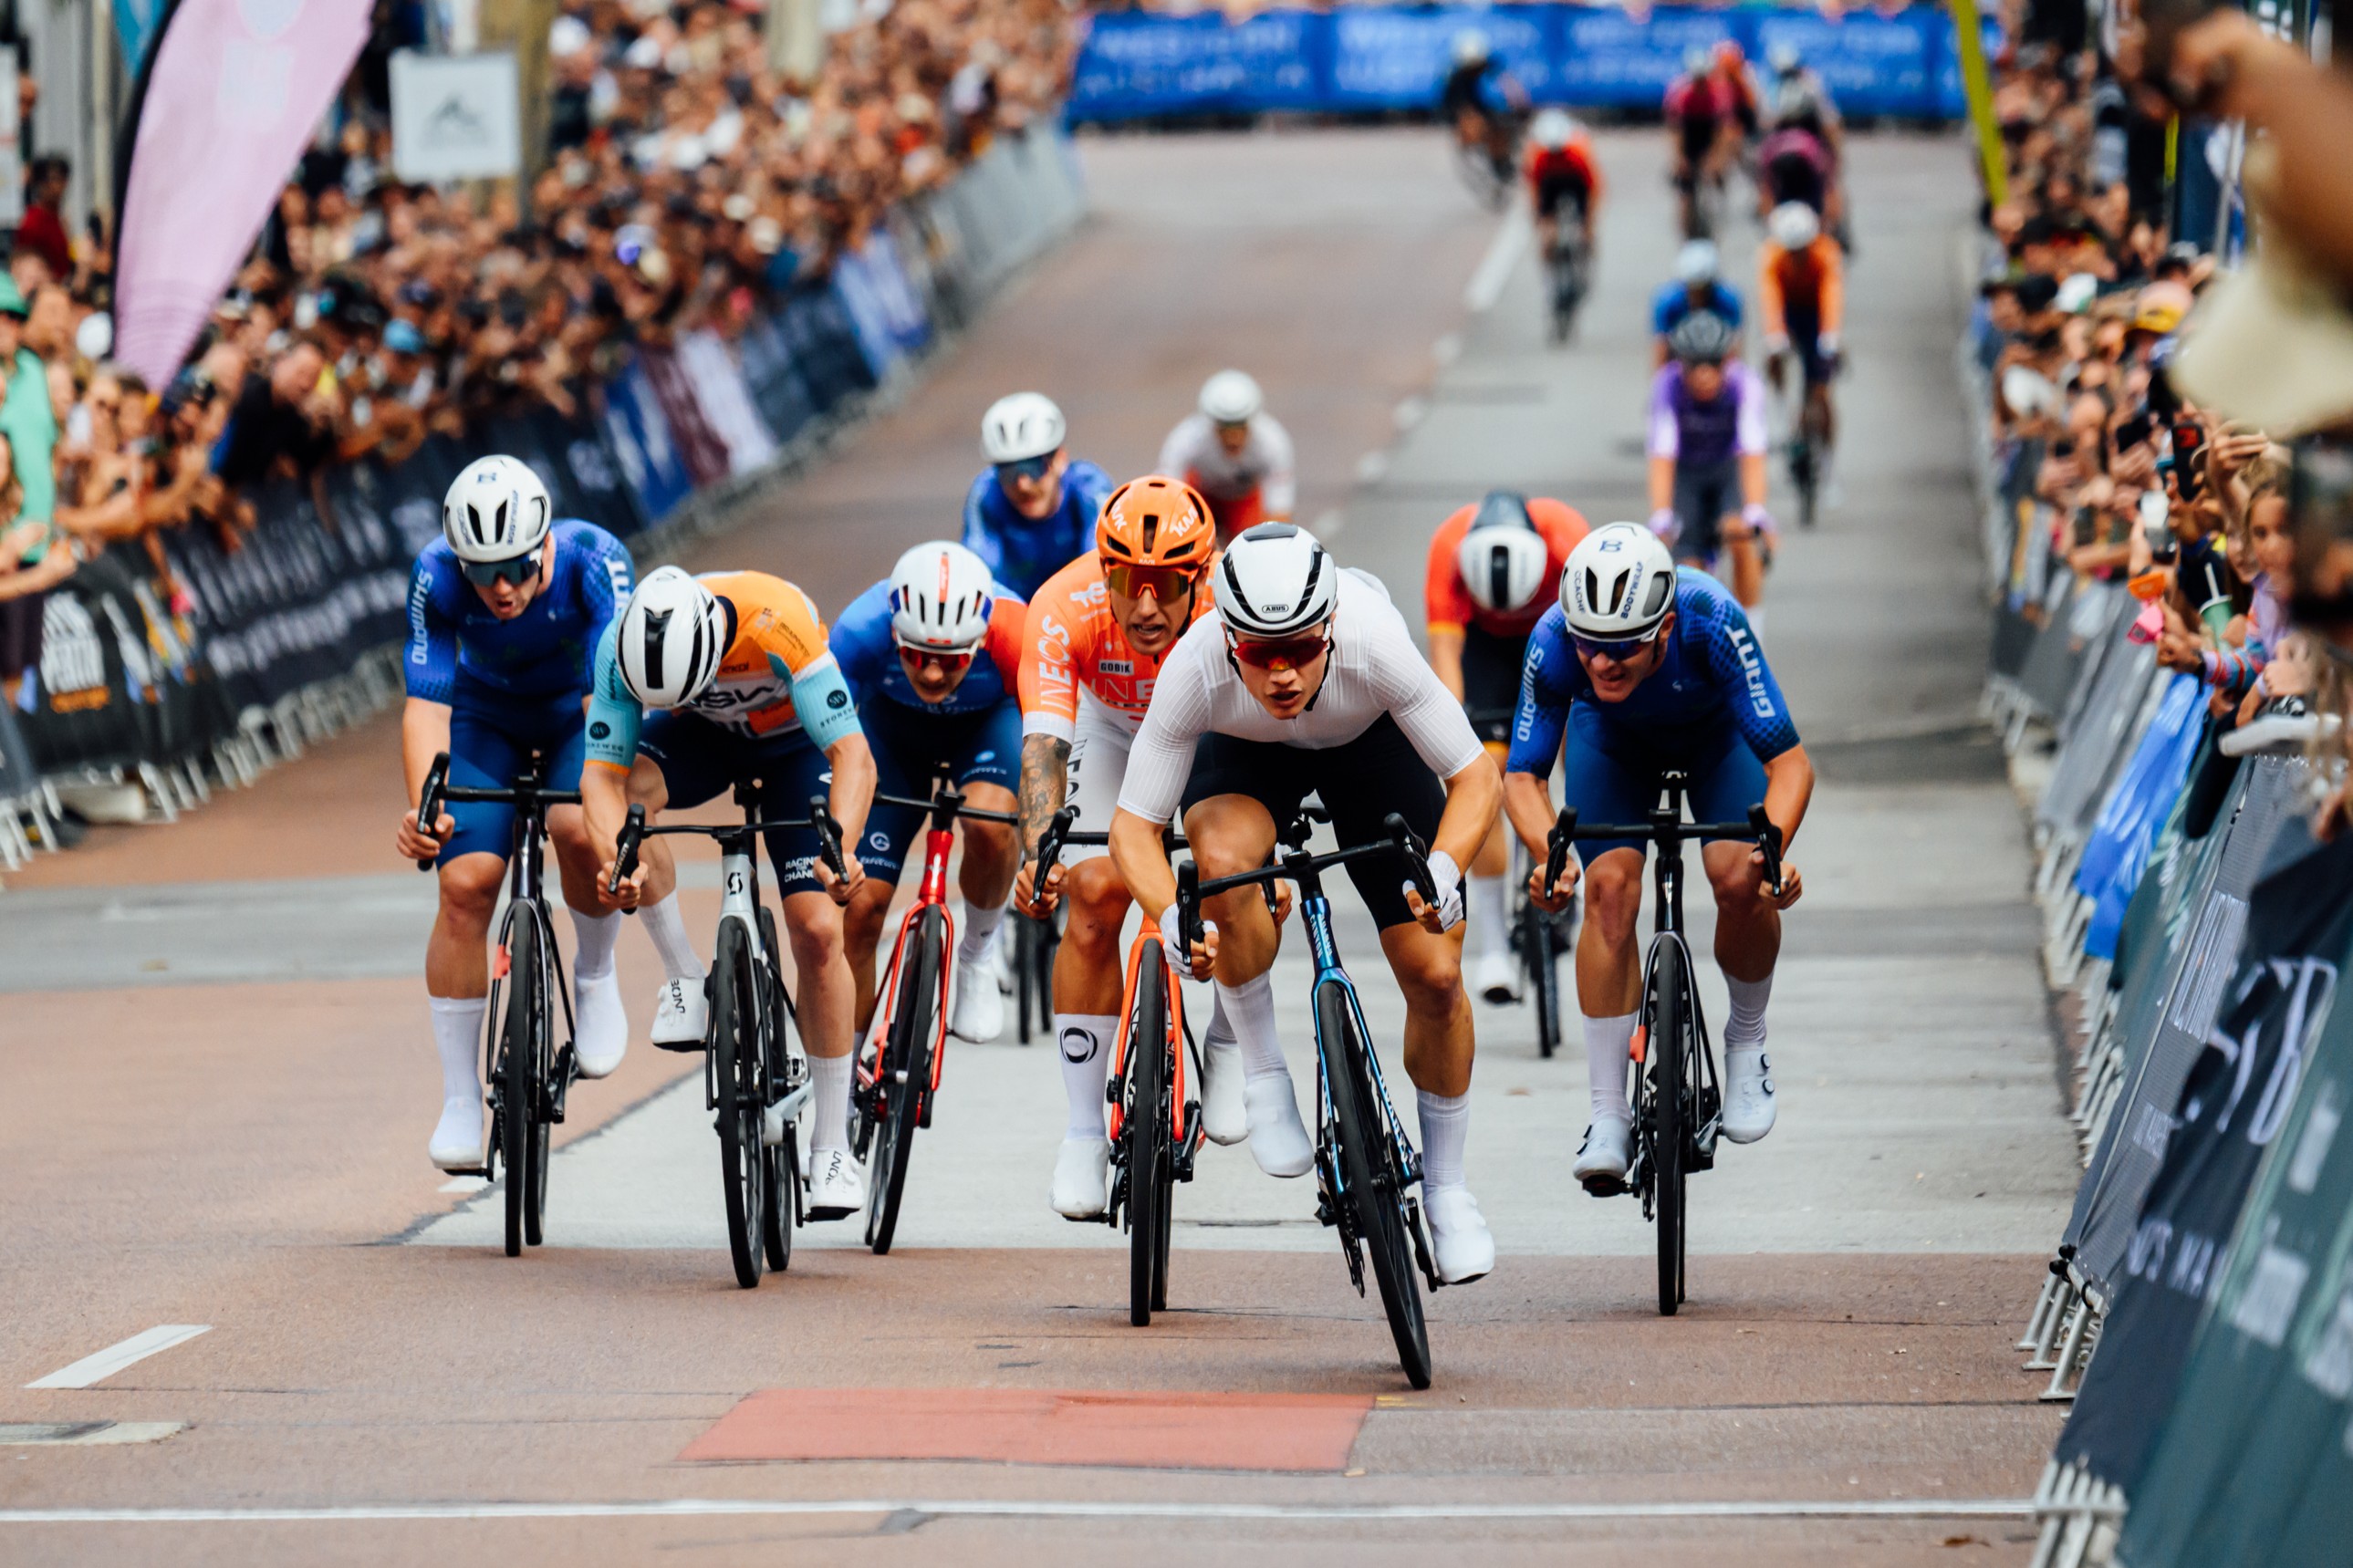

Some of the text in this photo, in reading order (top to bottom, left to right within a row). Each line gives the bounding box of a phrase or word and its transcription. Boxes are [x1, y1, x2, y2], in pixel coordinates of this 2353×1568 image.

[411, 569, 433, 665] SHIMANO
[1038, 615, 1073, 712] INEOS
[1100, 662, 1130, 673] GOBIK
[1517, 643, 1545, 742] SHIMANO
[1723, 625, 1775, 719] GIANT
[1310, 913, 1323, 959] CANYON
